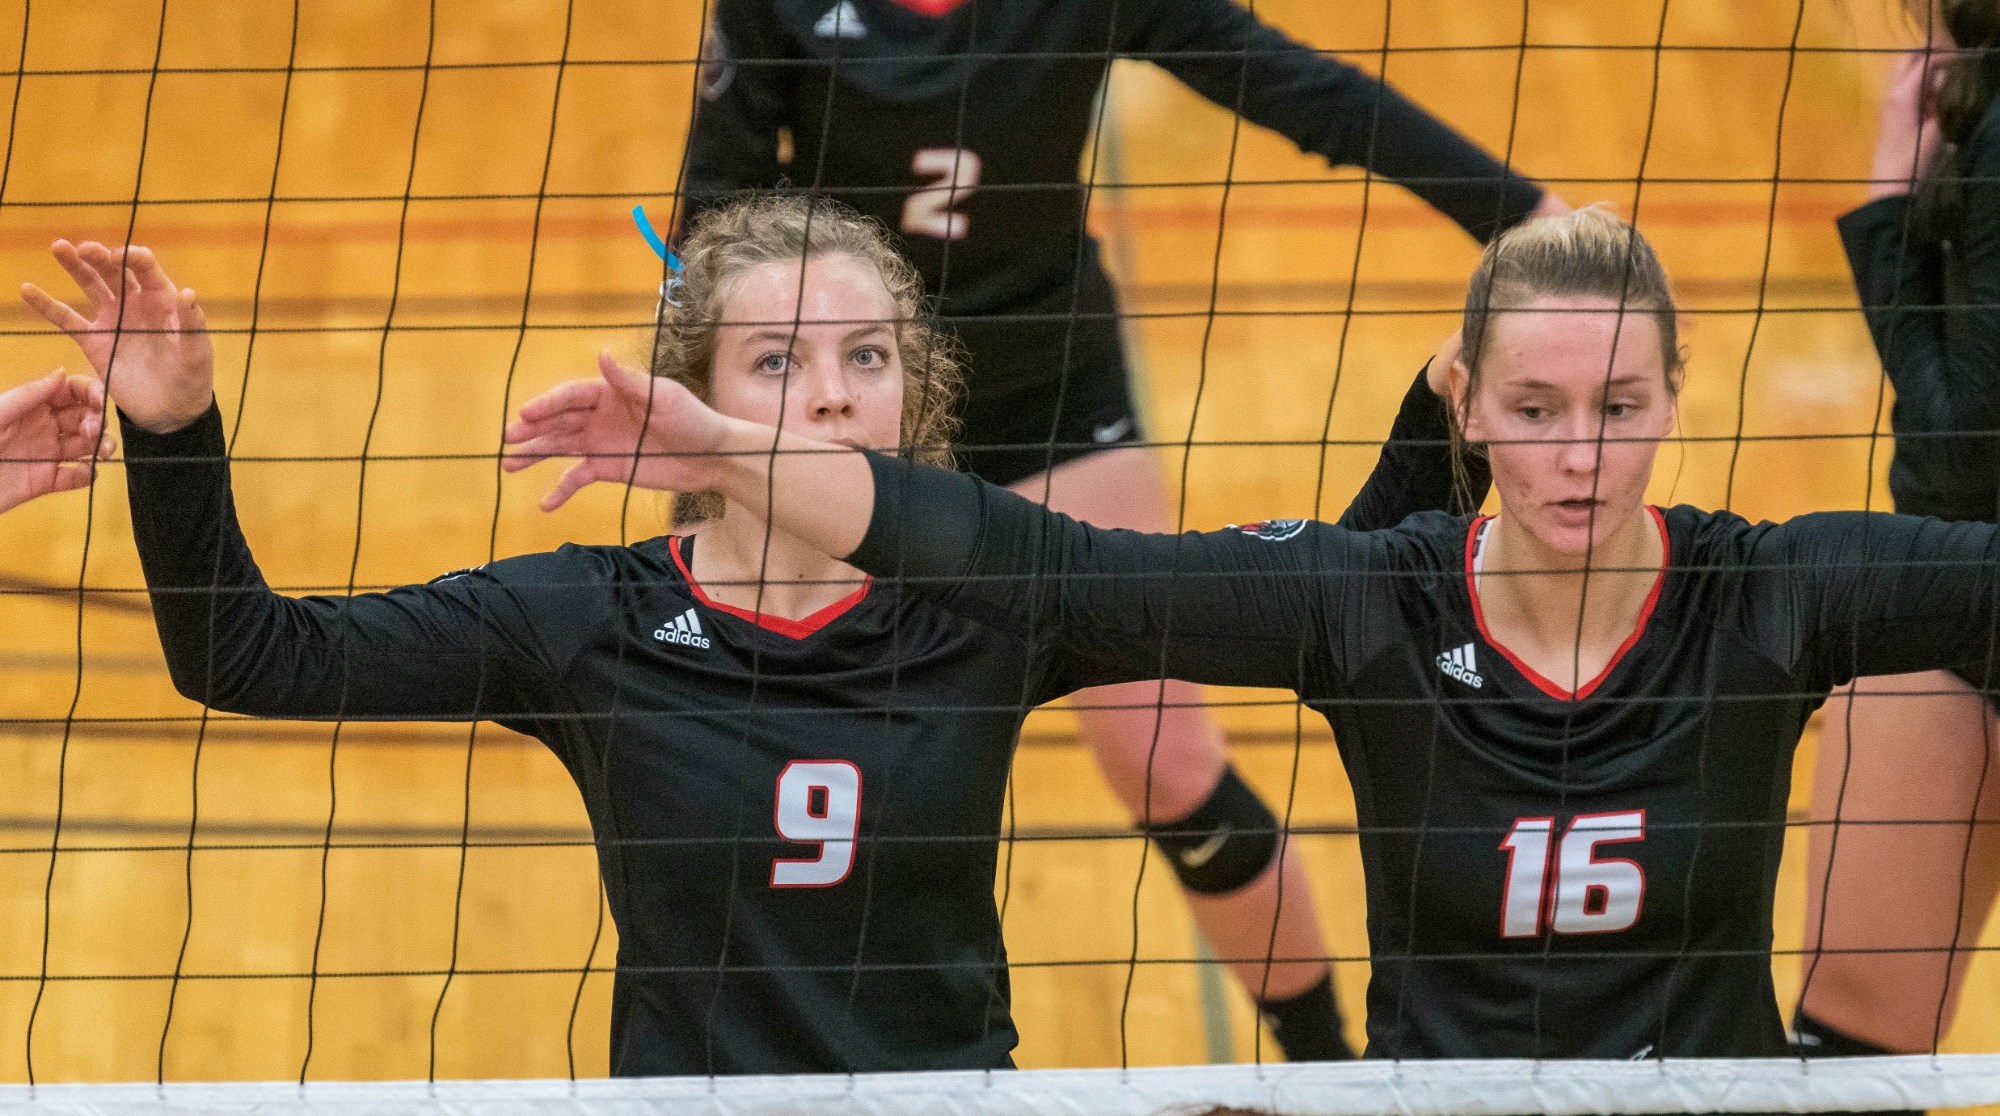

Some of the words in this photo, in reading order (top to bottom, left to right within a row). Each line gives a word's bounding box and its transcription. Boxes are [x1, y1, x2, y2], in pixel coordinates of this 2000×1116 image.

[901, 147, 981, 240] 2
[653, 628, 710, 649] adidas
[769, 758, 863, 889] 9
[1498, 808, 1646, 938] 16
